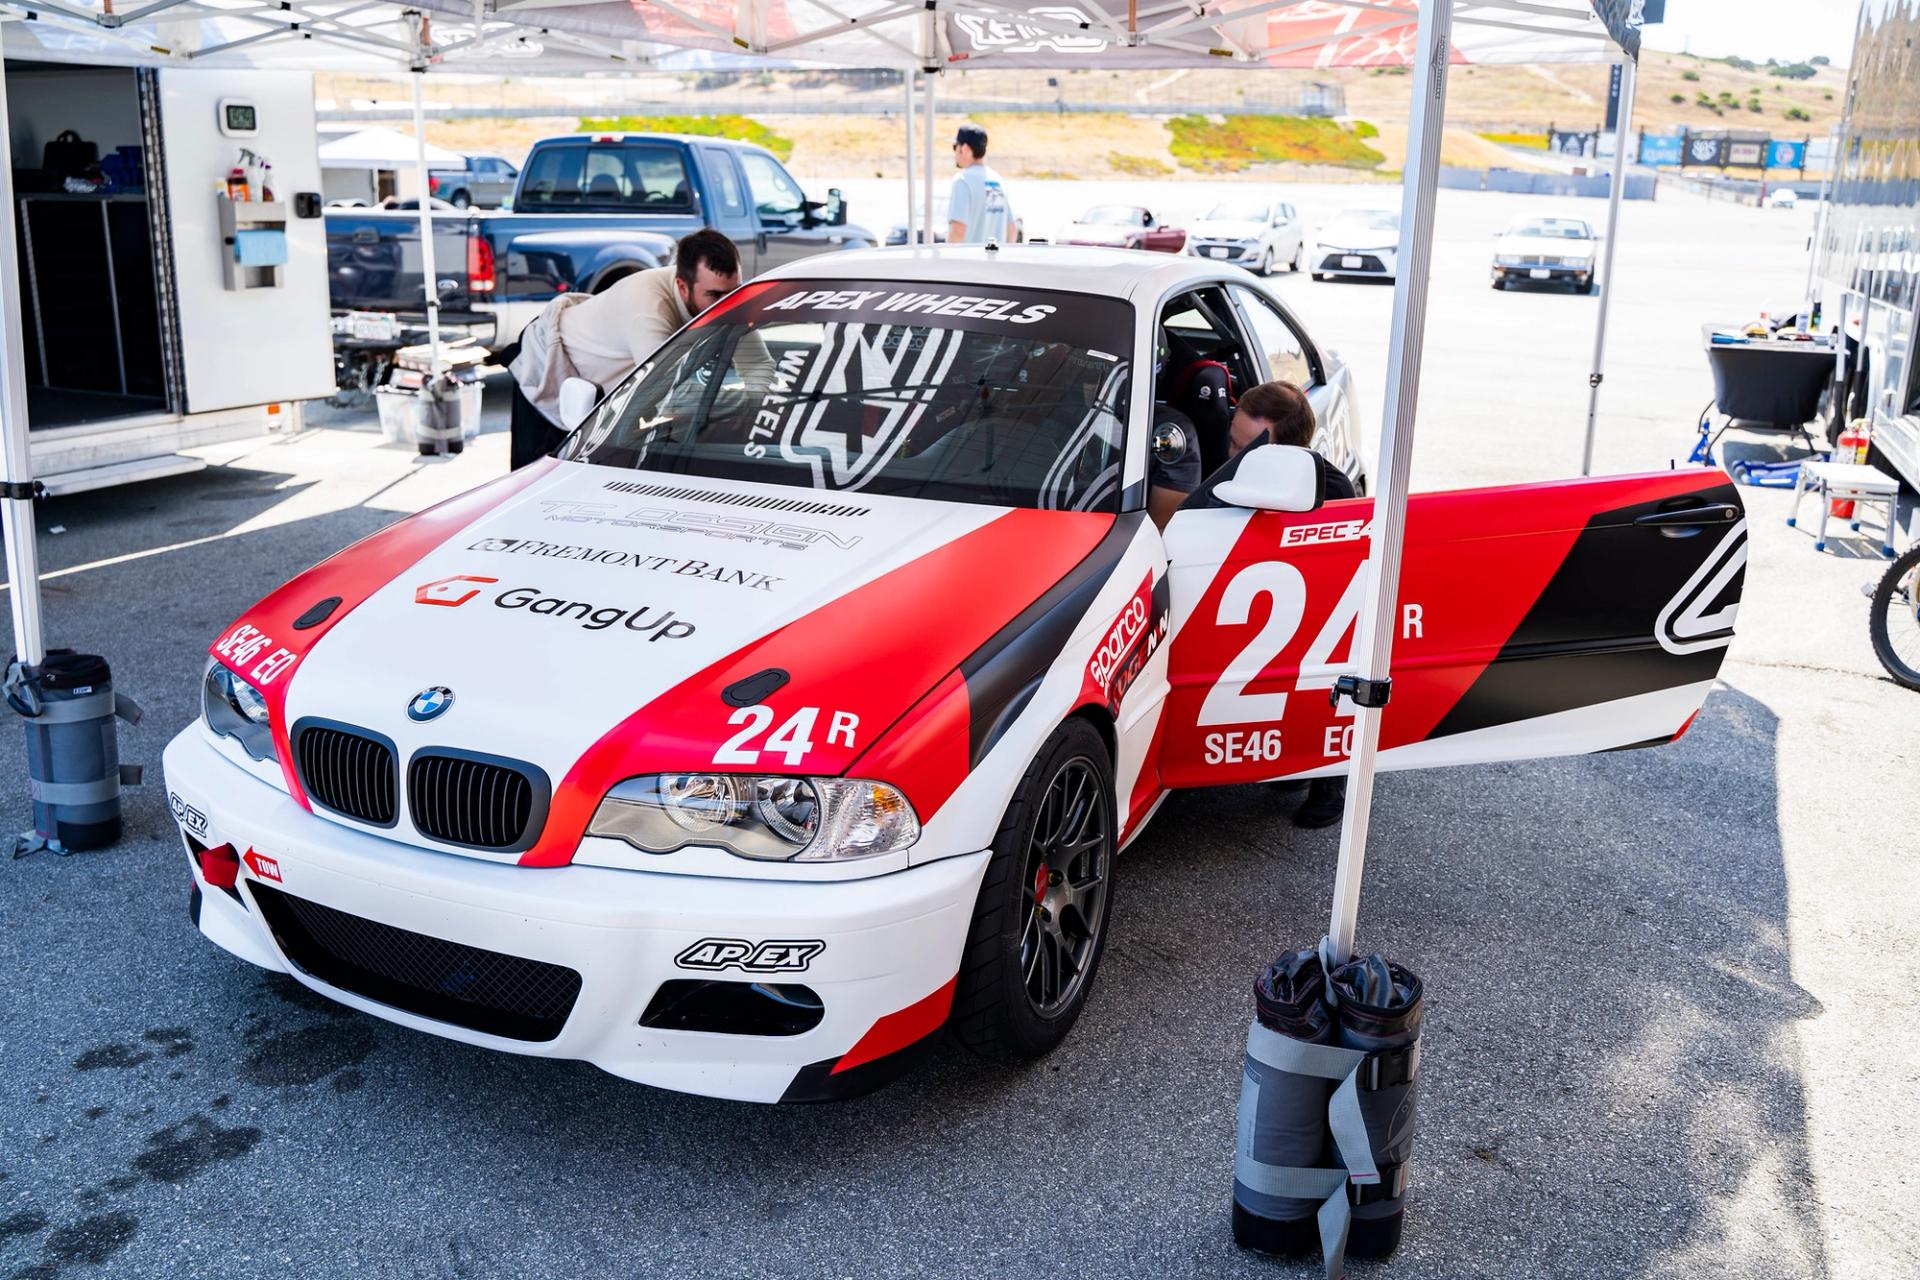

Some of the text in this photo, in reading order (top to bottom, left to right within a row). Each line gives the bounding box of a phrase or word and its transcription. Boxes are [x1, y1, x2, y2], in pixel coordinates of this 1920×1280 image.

[763, 291, 1057, 324] APEX WHEELS
[744, 350, 810, 459] WHEELS
[540, 500, 864, 550] TC DESIGN
[544, 515, 809, 551] MOTORSPORTS
[1288, 524, 1349, 543] SPEC
[509, 540, 786, 592] FREMONT BANK
[494, 588, 697, 642] GangUp
[216, 624, 273, 667] SE46
[1091, 596, 1148, 699] sparco
[1196, 559, 1371, 727] 24
[1403, 604, 1424, 639] R
[712, 704, 861, 767] 24 R
[1204, 729, 1282, 765] SE46
[255, 856, 280, 879] TOW
[684, 942, 819, 970] APEX
